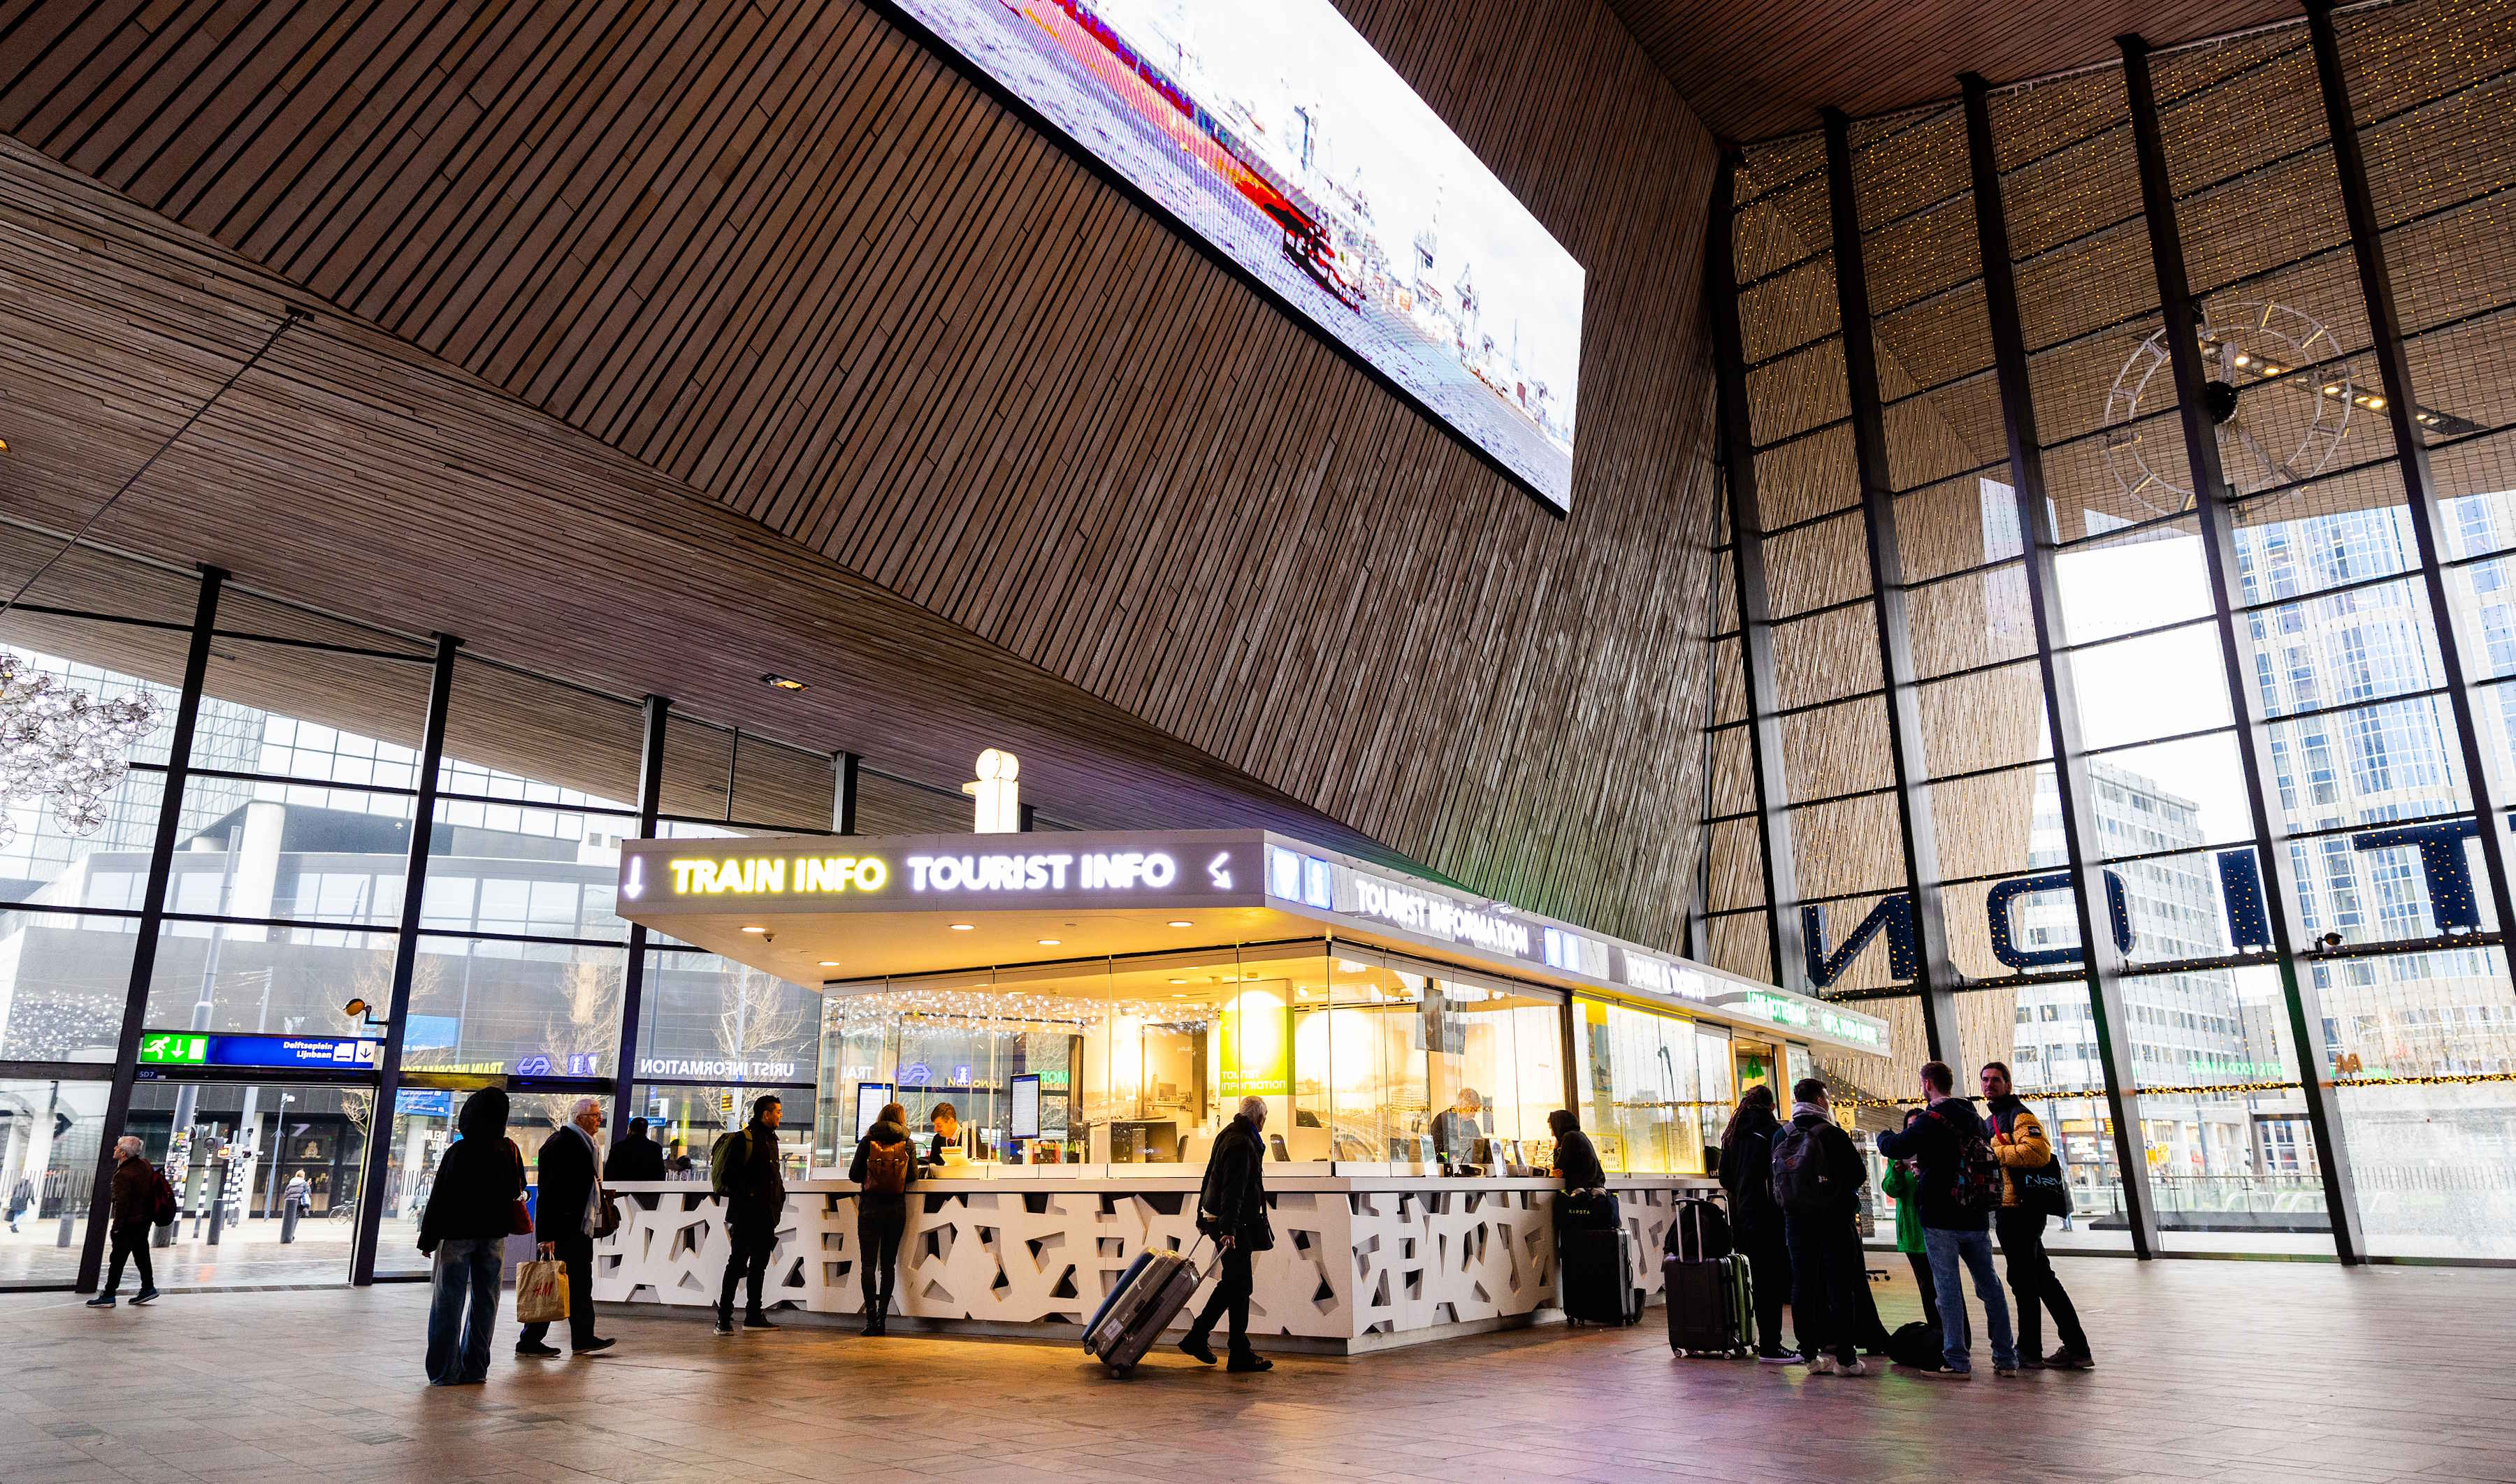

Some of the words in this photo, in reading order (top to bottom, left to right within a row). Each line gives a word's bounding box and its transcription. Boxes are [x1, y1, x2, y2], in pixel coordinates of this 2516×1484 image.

[670, 858, 785, 894] TRAIN
[793, 857, 887, 893] INFO
[906, 854, 1073, 892] TOURIST
[1080, 852, 1176, 889] INFO
[1355, 880, 1426, 926] TOURIST
[1428, 900, 1530, 955] INFORMATION
[283, 1041, 333, 1050] Delftseplein
[296, 1050, 332, 1059] Lijnbaan
